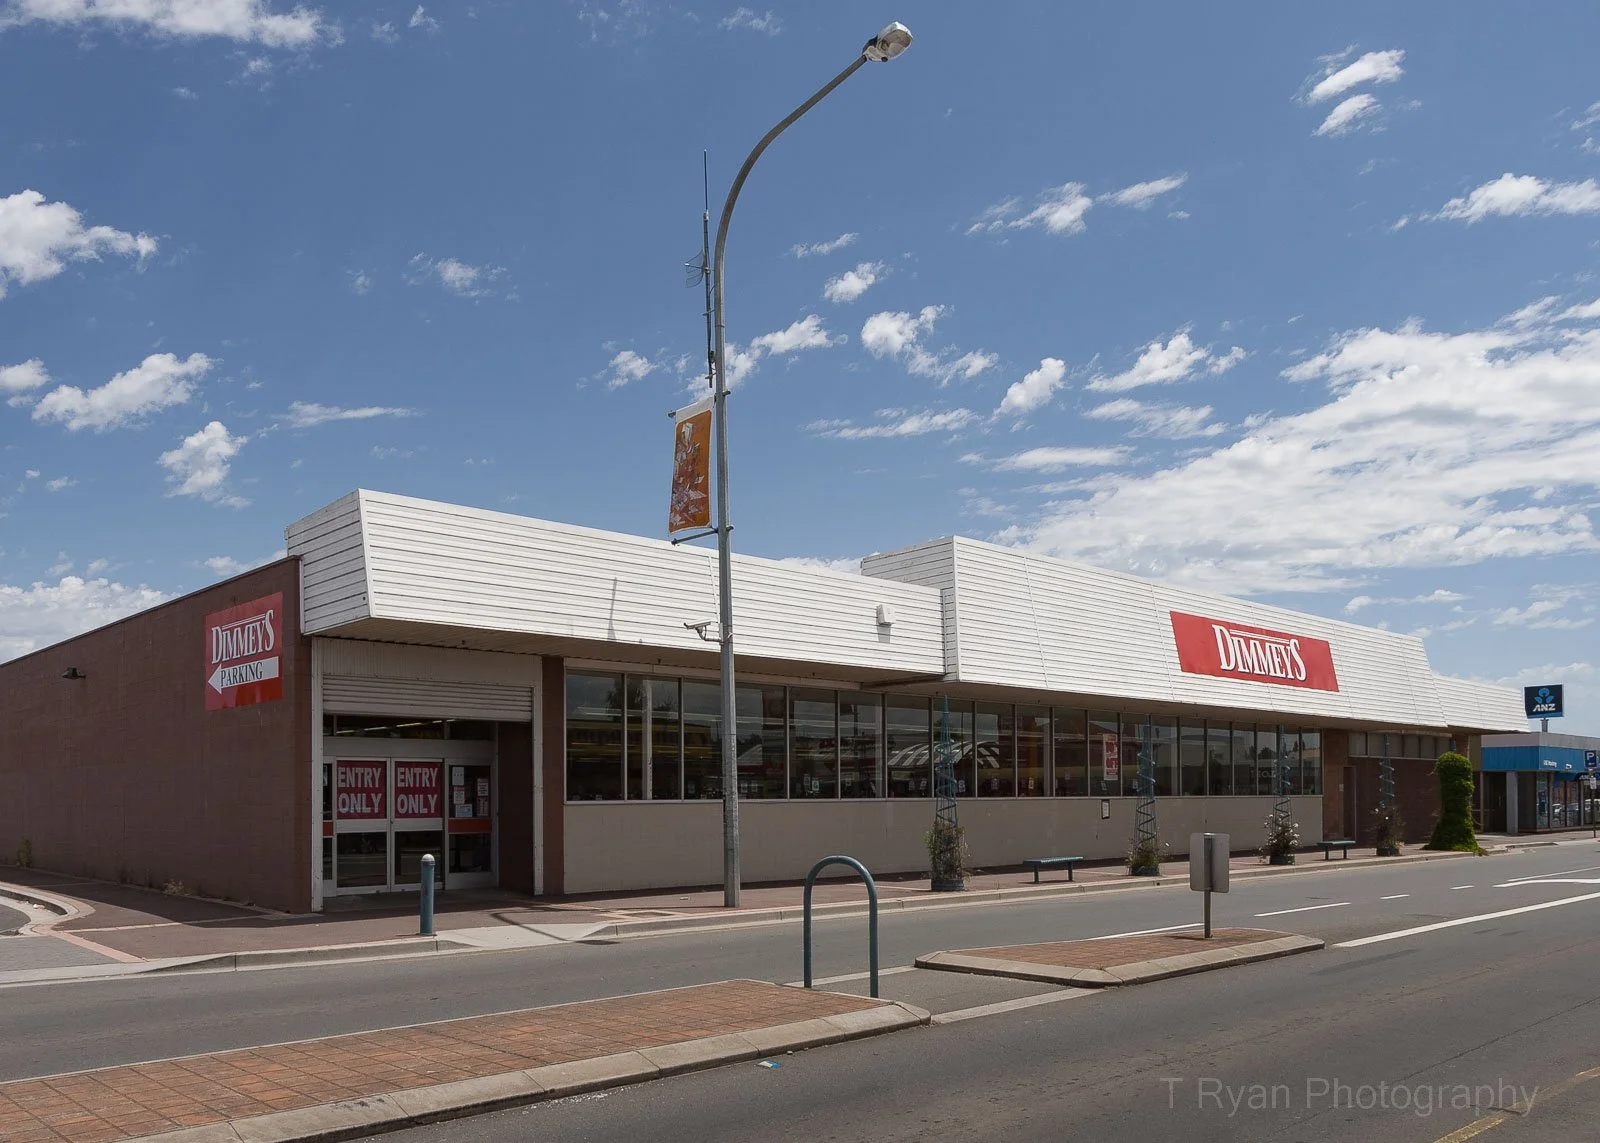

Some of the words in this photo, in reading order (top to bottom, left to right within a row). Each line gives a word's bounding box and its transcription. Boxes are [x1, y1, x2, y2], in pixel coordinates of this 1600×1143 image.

[211, 609, 275, 664] DIMMEYS
[1212, 624, 1307, 681] DIMMEYS
[220, 661, 263, 687] PARKING
[1532, 703, 1556, 712] ANZ
[1586, 752, 1595, 760] P
[338, 766, 382, 788] ENTRY
[397, 767, 439, 788] ENTRY
[338, 793, 382, 813] ONLY
[397, 794, 438, 814] ONLY
